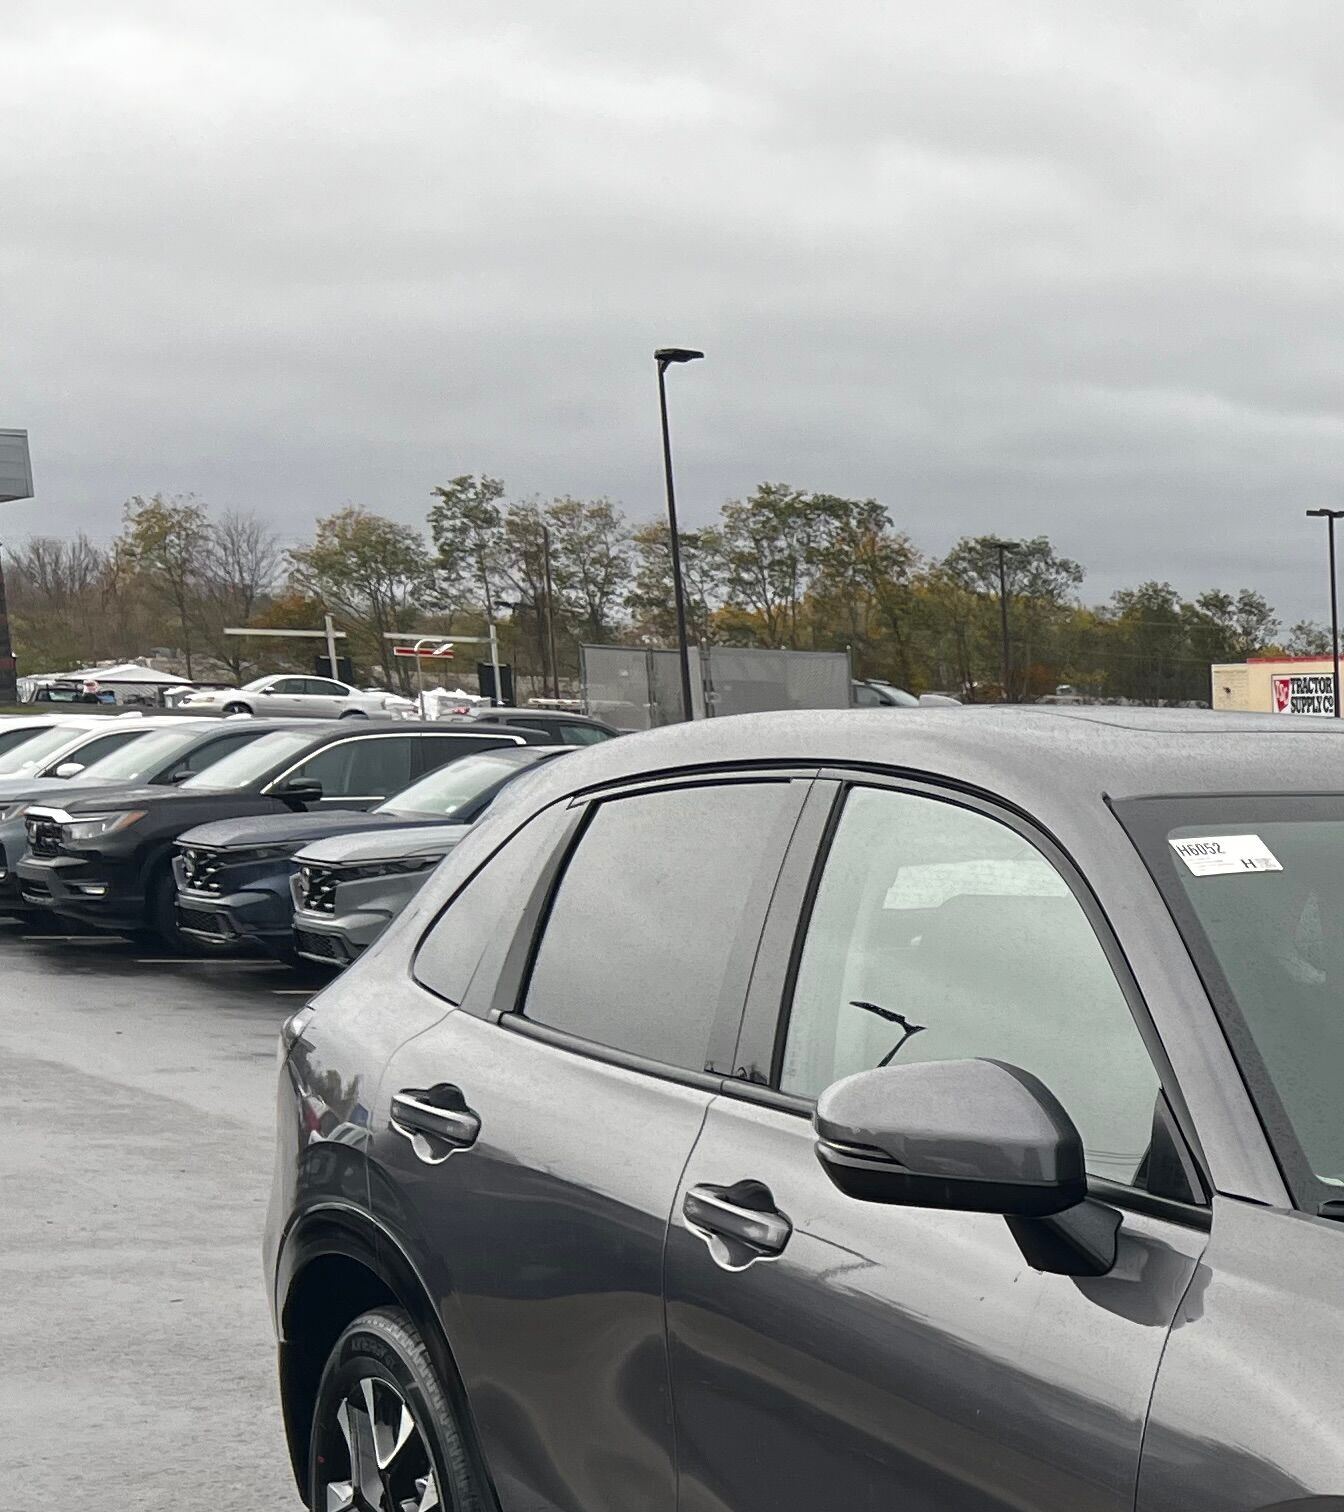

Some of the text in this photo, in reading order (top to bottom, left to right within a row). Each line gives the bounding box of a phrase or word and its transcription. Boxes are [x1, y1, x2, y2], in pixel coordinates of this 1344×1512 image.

[1290, 677, 1333, 694] TRACTOR
[1290, 696, 1322, 713] SUPPLY
[1176, 842, 1226, 856] H6052
[1240, 858, 1257, 869] H
